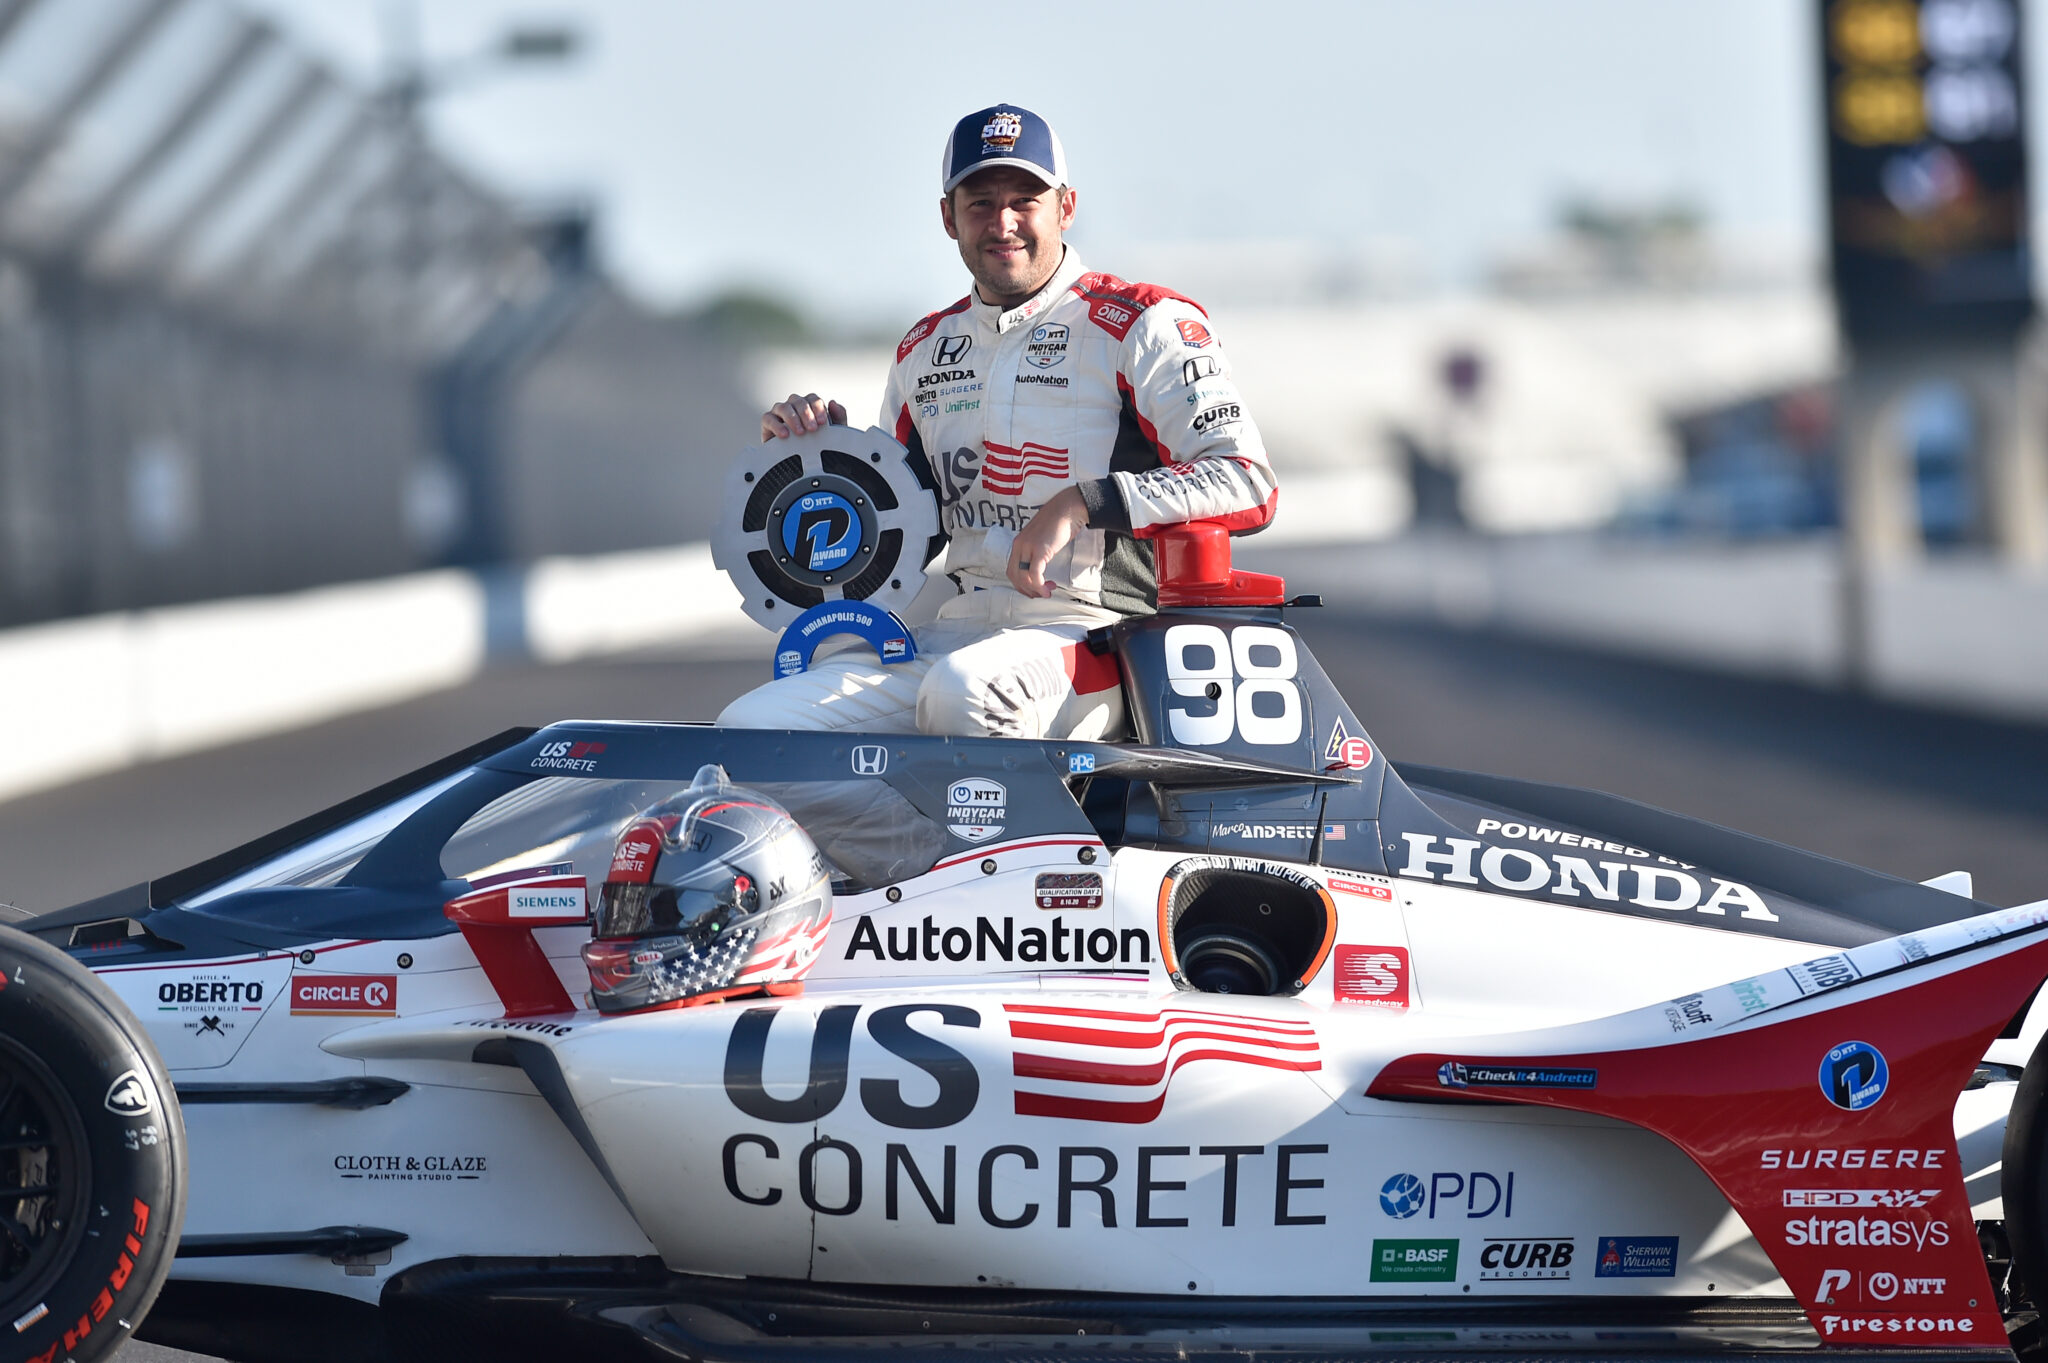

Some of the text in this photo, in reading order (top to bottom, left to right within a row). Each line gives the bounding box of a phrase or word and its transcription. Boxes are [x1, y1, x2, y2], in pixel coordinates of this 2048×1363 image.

[981, 124, 1021, 138] 500
[1009, 310, 1024, 324] US
[1098, 306, 1129, 324] OMP
[902, 324, 928, 348] OMP
[1048, 330, 1065, 338] NTT
[1028, 343, 1067, 351] INDYCAR
[918, 370, 976, 388] HONDA
[1016, 375, 1069, 385] AutoNation
[940, 383, 984, 396] SURGERE
[924, 405, 939, 416] PDI
[945, 400, 981, 413] UniFirst
[1192, 405, 1241, 430] CURB
[931, 447, 979, 507] US
[815, 496, 833, 506] NTT
[951, 500, 1046, 531] NCRE
[813, 548, 847, 561] AWARD
[801, 612, 873, 637] INDIANAPOLIS 500
[1164, 624, 1303, 745] 98
[539, 741, 572, 757] US
[1347, 742, 1366, 766] E
[530, 757, 597, 772] CONCRETE
[1070, 755, 1094, 772] PPG
[974, 790, 1000, 801] NTT
[947, 807, 1005, 819] INDYCAR
[958, 817, 992, 825] SERIES
[1212, 823, 1320, 838] Marco ANDRETT
[1476, 818, 1697, 871] POWERED BY
[1211, 857, 1231, 869] OUT
[1231, 857, 1262, 872] WHAT
[1263, 862, 1285, 877] YOU
[1282, 868, 1304, 884] PUT
[1299, 877, 1316, 890] IN
[1400, 832, 1779, 922] HONDA
[1332, 881, 1370, 894] CIRCLE
[516, 896, 577, 907] SIEMENS
[844, 915, 1150, 963] AutoNation
[637, 952, 661, 963] BELL
[1803, 955, 1855, 988] CURB
[158, 982, 263, 1003] OBERTO
[299, 983, 388, 1005] CIRCLE K
[1841, 1044, 1857, 1055] NTT
[723, 1003, 981, 1129] US
[1470, 1071, 1593, 1084] #CheckIt4Andretti
[1852, 1084, 1880, 1101] AWARD
[334, 1156, 487, 1171] CLOTH & GLAZE
[1760, 1150, 1946, 1169] SURGERE
[721, 1132, 1329, 1229] CONCRETE
[1429, 1171, 1514, 1219] PDI
[1785, 1192, 1860, 1206] HPD
[1785, 1215, 1949, 1252] stratasys
[1405, 1249, 1448, 1262] BASF
[1480, 1243, 1575, 1269] CURB
[1625, 1245, 1672, 1256] SHERWIN
[1623, 1256, 1671, 1267] WILLIAMS
[1414, 1266, 1447, 1274] chemistry
[1480, 1270, 1571, 1278] RECORDS
[1903, 1278, 1946, 1295] NTT
[1821, 1315, 1974, 1336] Firestone
